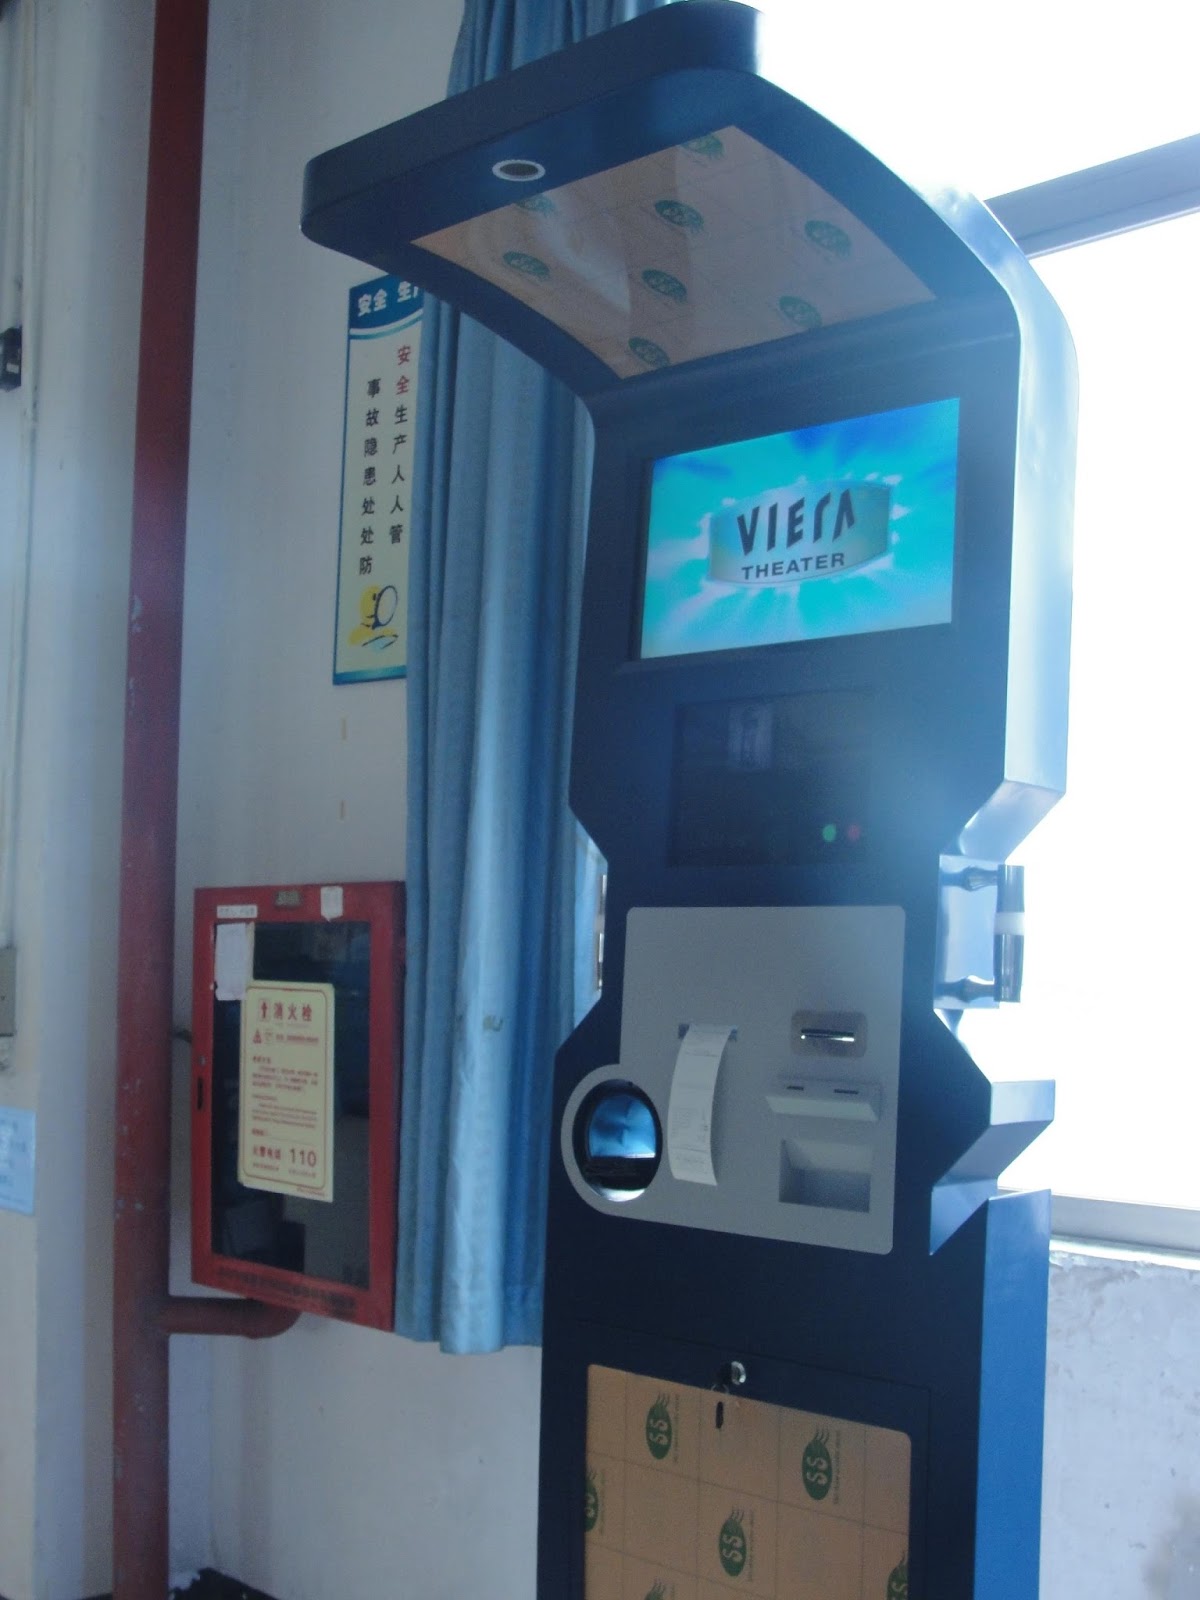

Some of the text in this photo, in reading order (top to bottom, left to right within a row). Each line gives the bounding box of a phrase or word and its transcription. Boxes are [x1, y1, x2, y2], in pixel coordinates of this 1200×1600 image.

[390, 345, 411, 544] 安全生产人人管
[359, 378, 381, 575] 事故隐患处处防
[742, 552, 845, 580] THEATER
[274, 1003, 312, 1021] 消火栓
[290, 1148, 316, 1167] 110
